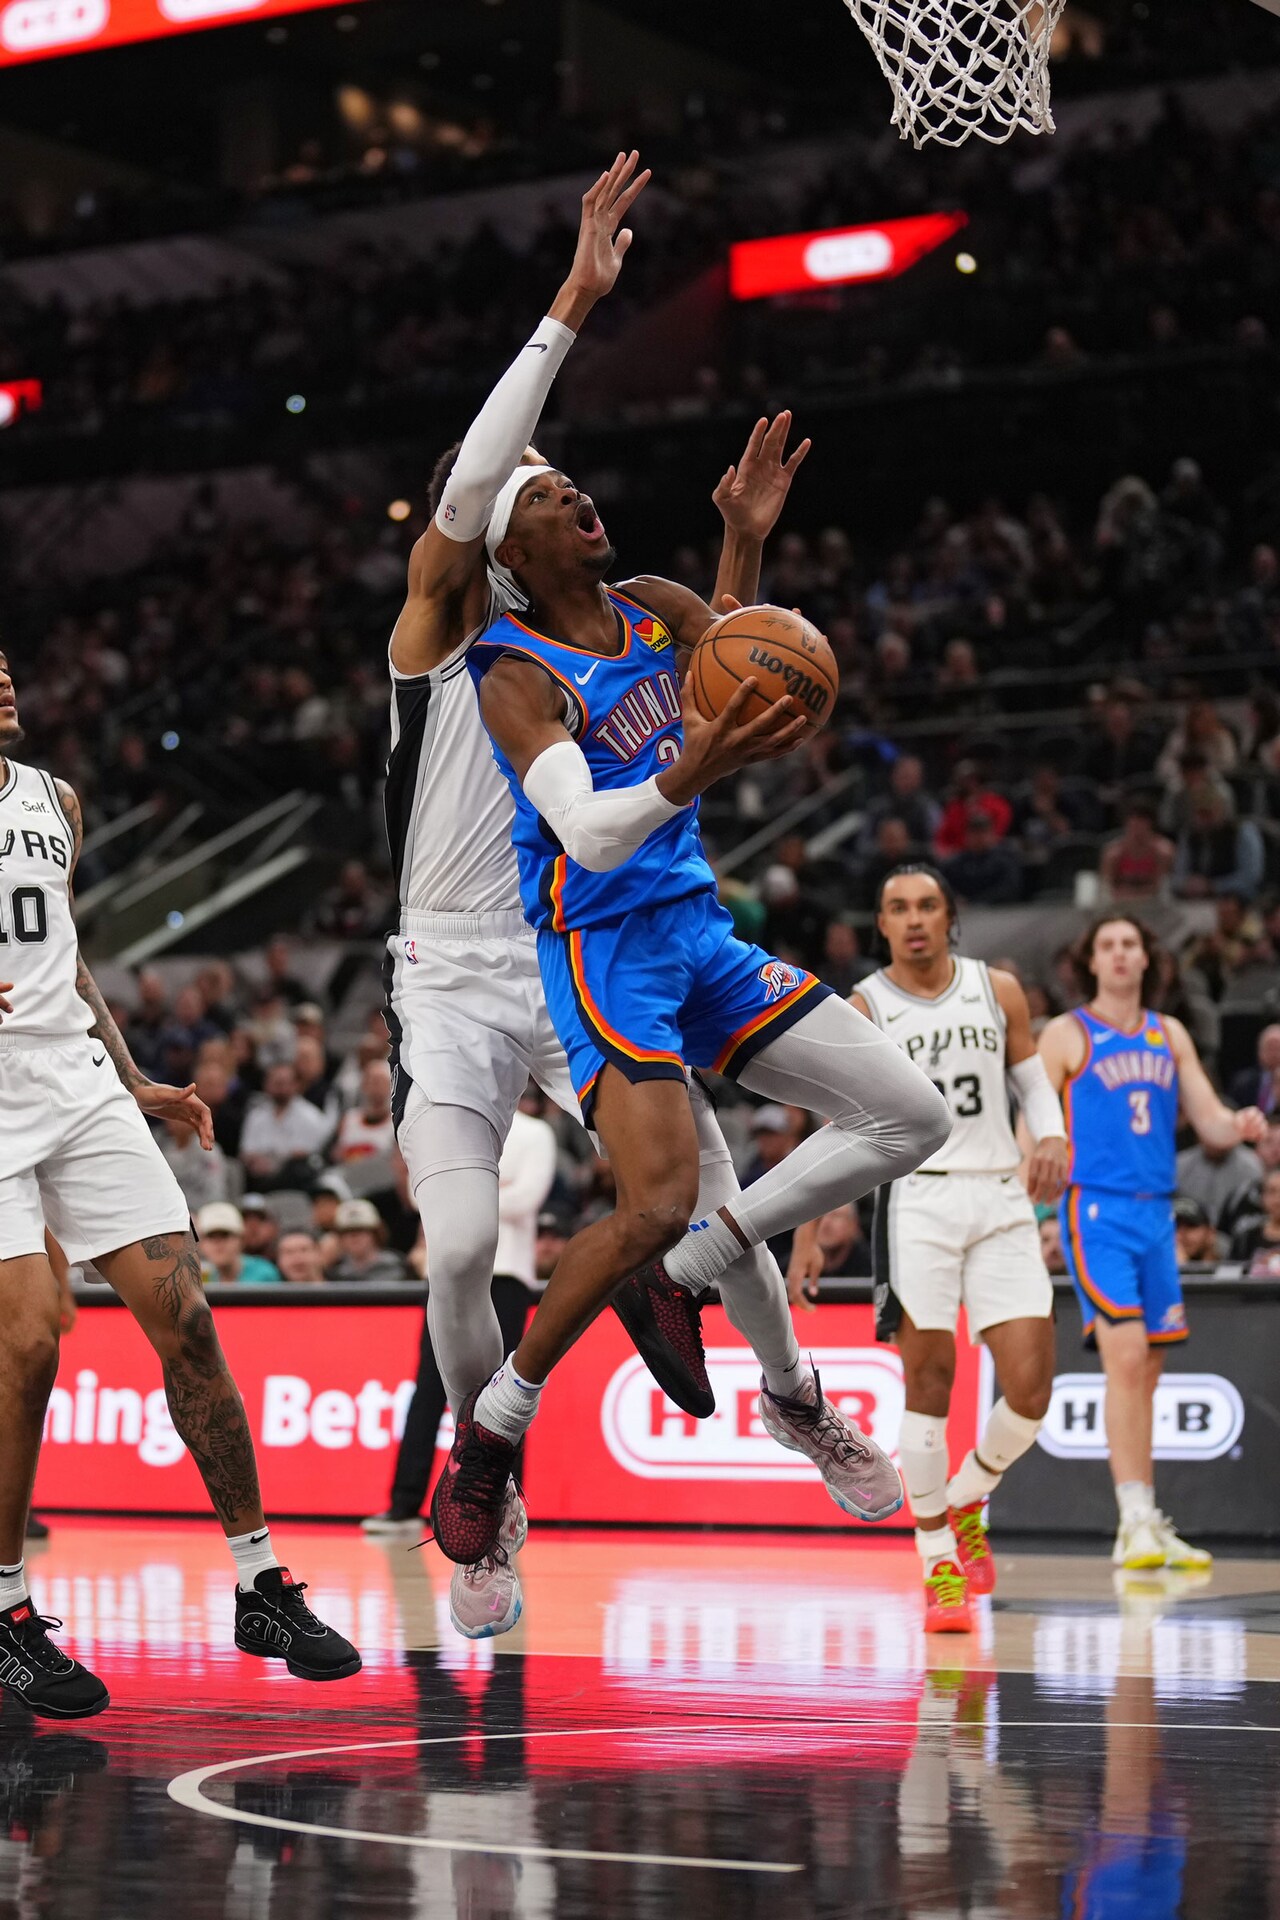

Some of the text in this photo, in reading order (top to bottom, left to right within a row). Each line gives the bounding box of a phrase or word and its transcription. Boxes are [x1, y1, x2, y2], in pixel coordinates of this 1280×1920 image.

[748, 646, 828, 715] Wilson
[592, 669, 684, 764] THUND
[1129, 1090, 1151, 1135] 3
[240, 1612, 292, 1651] AIR
